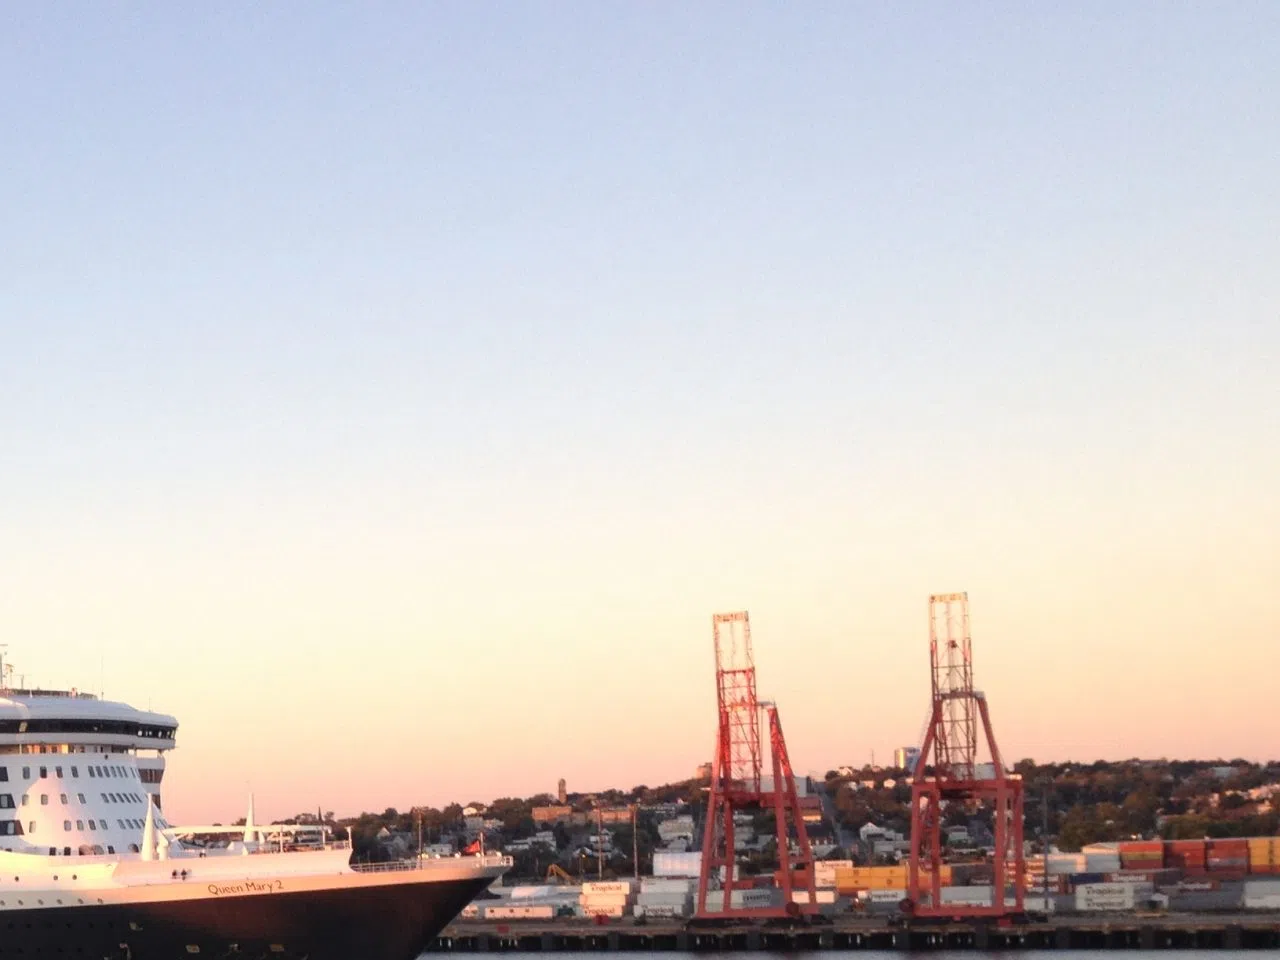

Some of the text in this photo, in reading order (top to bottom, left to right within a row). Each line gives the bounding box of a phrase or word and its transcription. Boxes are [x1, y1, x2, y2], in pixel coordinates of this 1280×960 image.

[208, 880, 284, 896] Queen Mary 2
[1086, 886, 1125, 896] Tropical
[1086, 898, 1125, 908] Tropical
